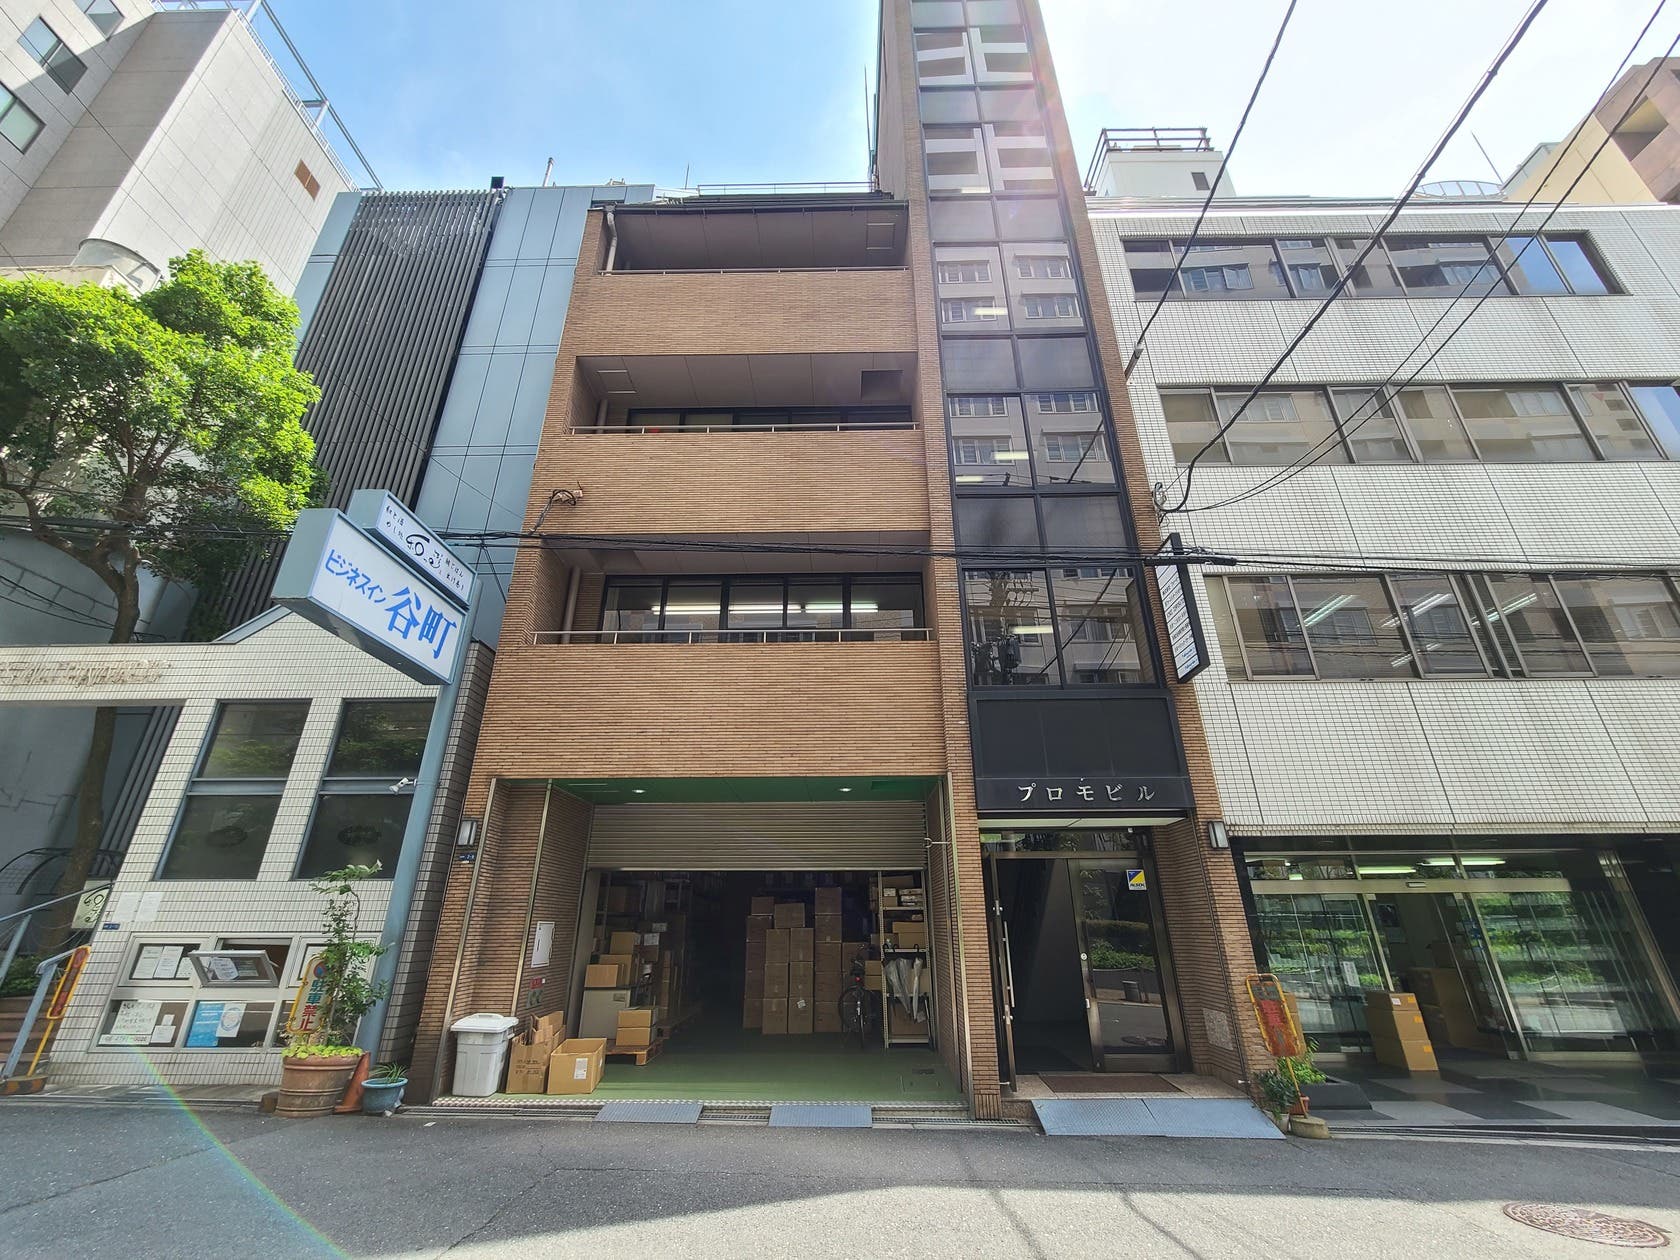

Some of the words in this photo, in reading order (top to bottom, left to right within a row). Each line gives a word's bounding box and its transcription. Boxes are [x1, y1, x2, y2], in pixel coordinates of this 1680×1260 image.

[324, 549, 387, 604] ビジネスイン
[384, 586, 457, 659] 谷町
[1018, 782, 1155, 801] プロモビル
[300, 979, 325, 1031] 駐車禁止
